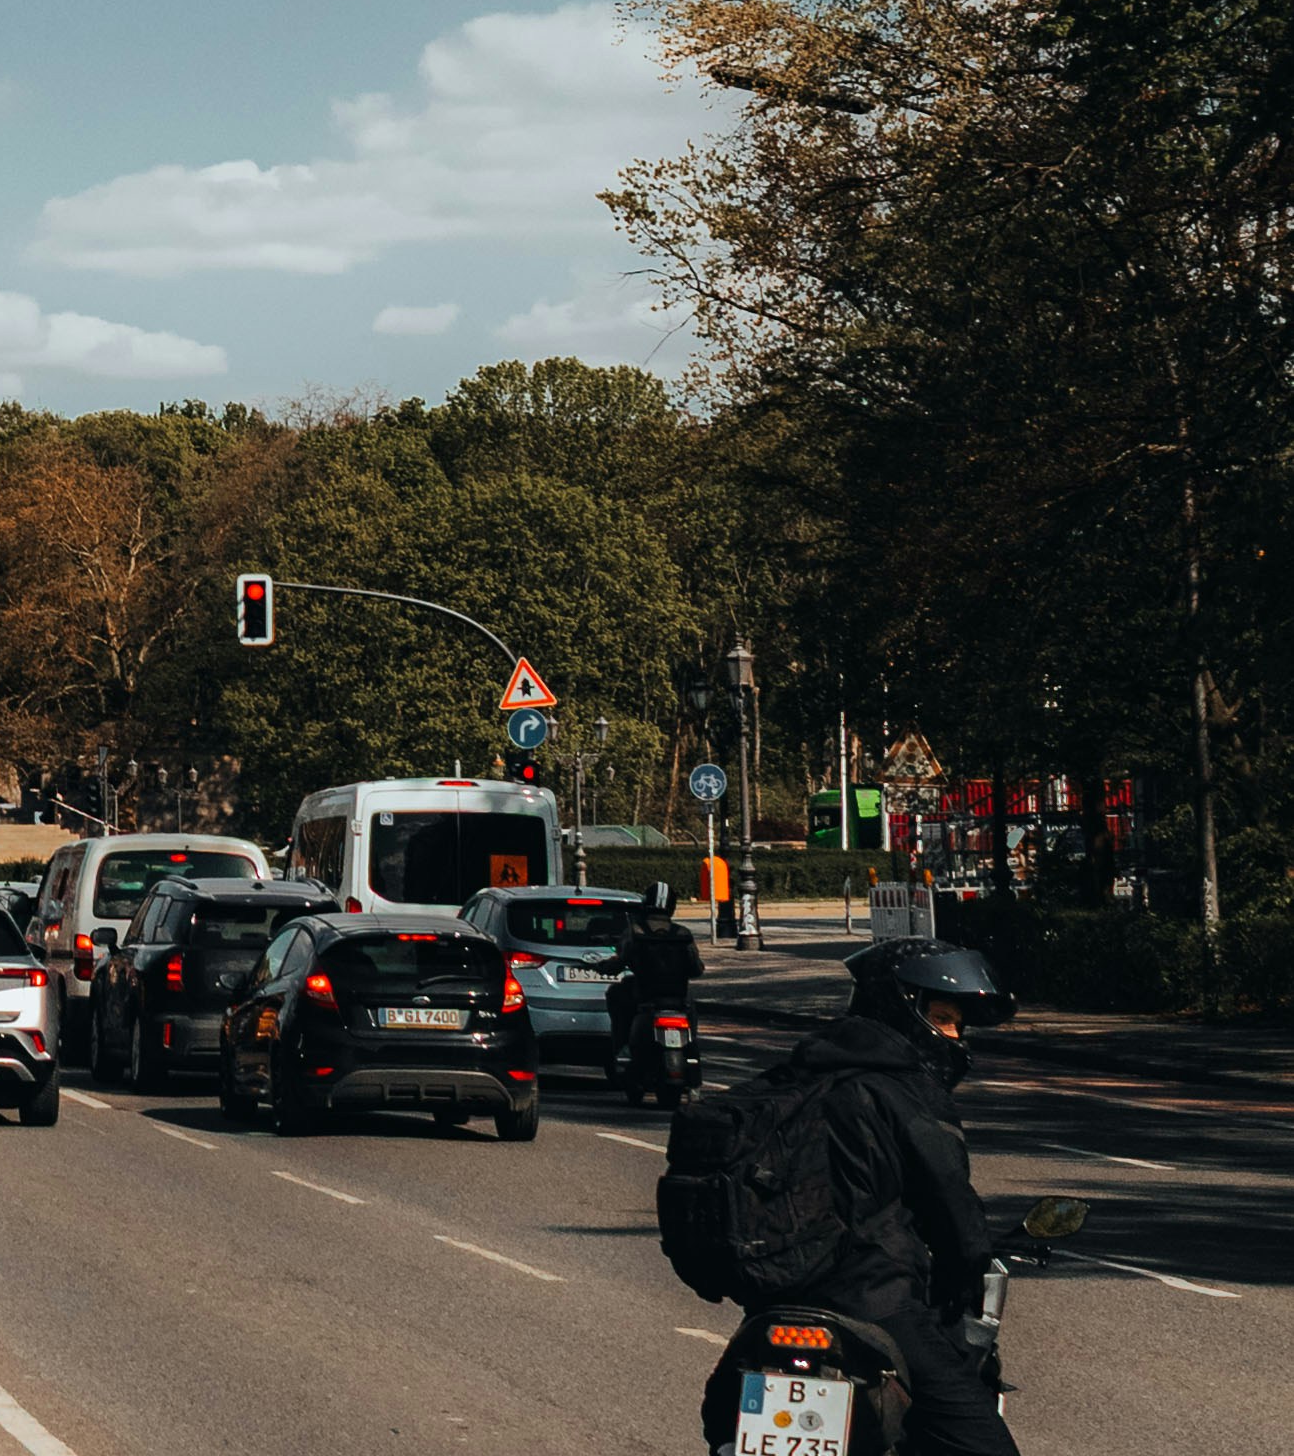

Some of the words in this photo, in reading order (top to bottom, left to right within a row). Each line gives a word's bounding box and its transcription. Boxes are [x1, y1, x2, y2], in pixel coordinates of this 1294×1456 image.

[388, 1010, 397, 1022] B
[425, 1011, 458, 1024] 7400
[788, 1380, 806, 1403] B
